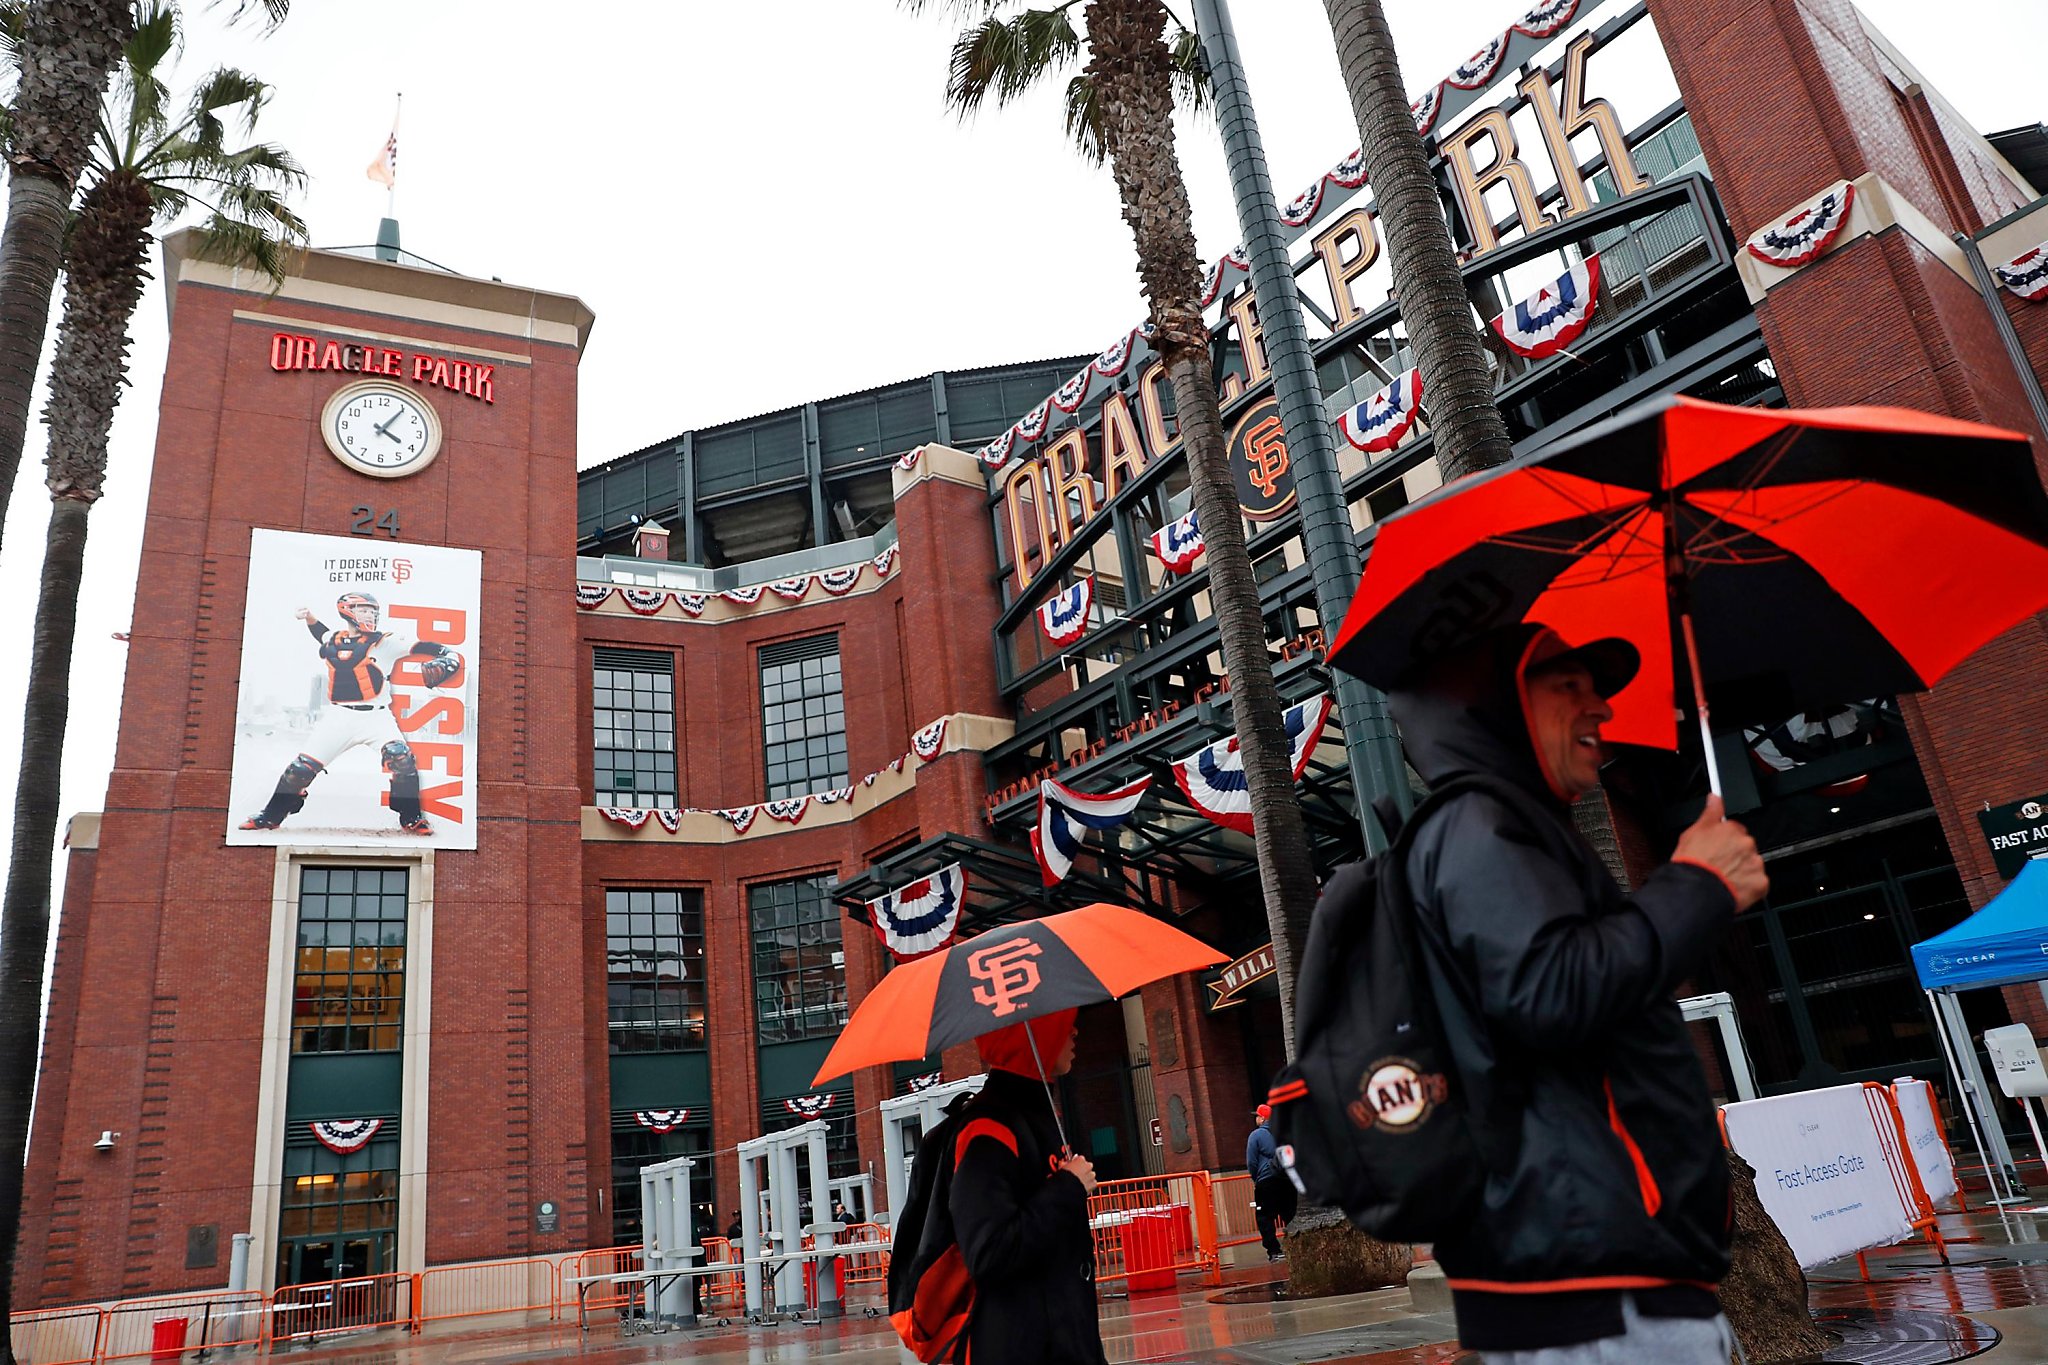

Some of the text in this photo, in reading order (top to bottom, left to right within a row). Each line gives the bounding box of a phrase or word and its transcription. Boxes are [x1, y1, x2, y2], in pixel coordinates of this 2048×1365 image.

[270, 29, 1656, 592] ORACE PRK ORACLE PARK
[363, 399, 373, 409] 11
[379, 397, 390, 407] 12
[348, 408, 361, 417] 10
[411, 416, 417, 424] 2
[341, 421, 348, 430] 9
[416, 430, 422, 439] 3
[347, 436, 354, 445] 8
[360, 448, 367, 456] 7
[408, 444, 415, 453] 4
[377, 454, 384, 463] 6
[395, 452, 402, 461] 5
[351, 504, 400, 538] 24
[324, 557, 388, 570] IT DOESN'T
[391, 558, 413, 584] SF
[329, 571, 387, 582] GET MORE
[1991, 830, 2029, 850] FAST
[1956, 953, 1996, 965] CLEAR
[1223, 952, 1273, 988] WILL
[967, 937, 1043, 1018] SF
[2012, 1059, 2036, 1067] CLEAR
[1775, 1155, 1865, 1190] Fast Access Gate
